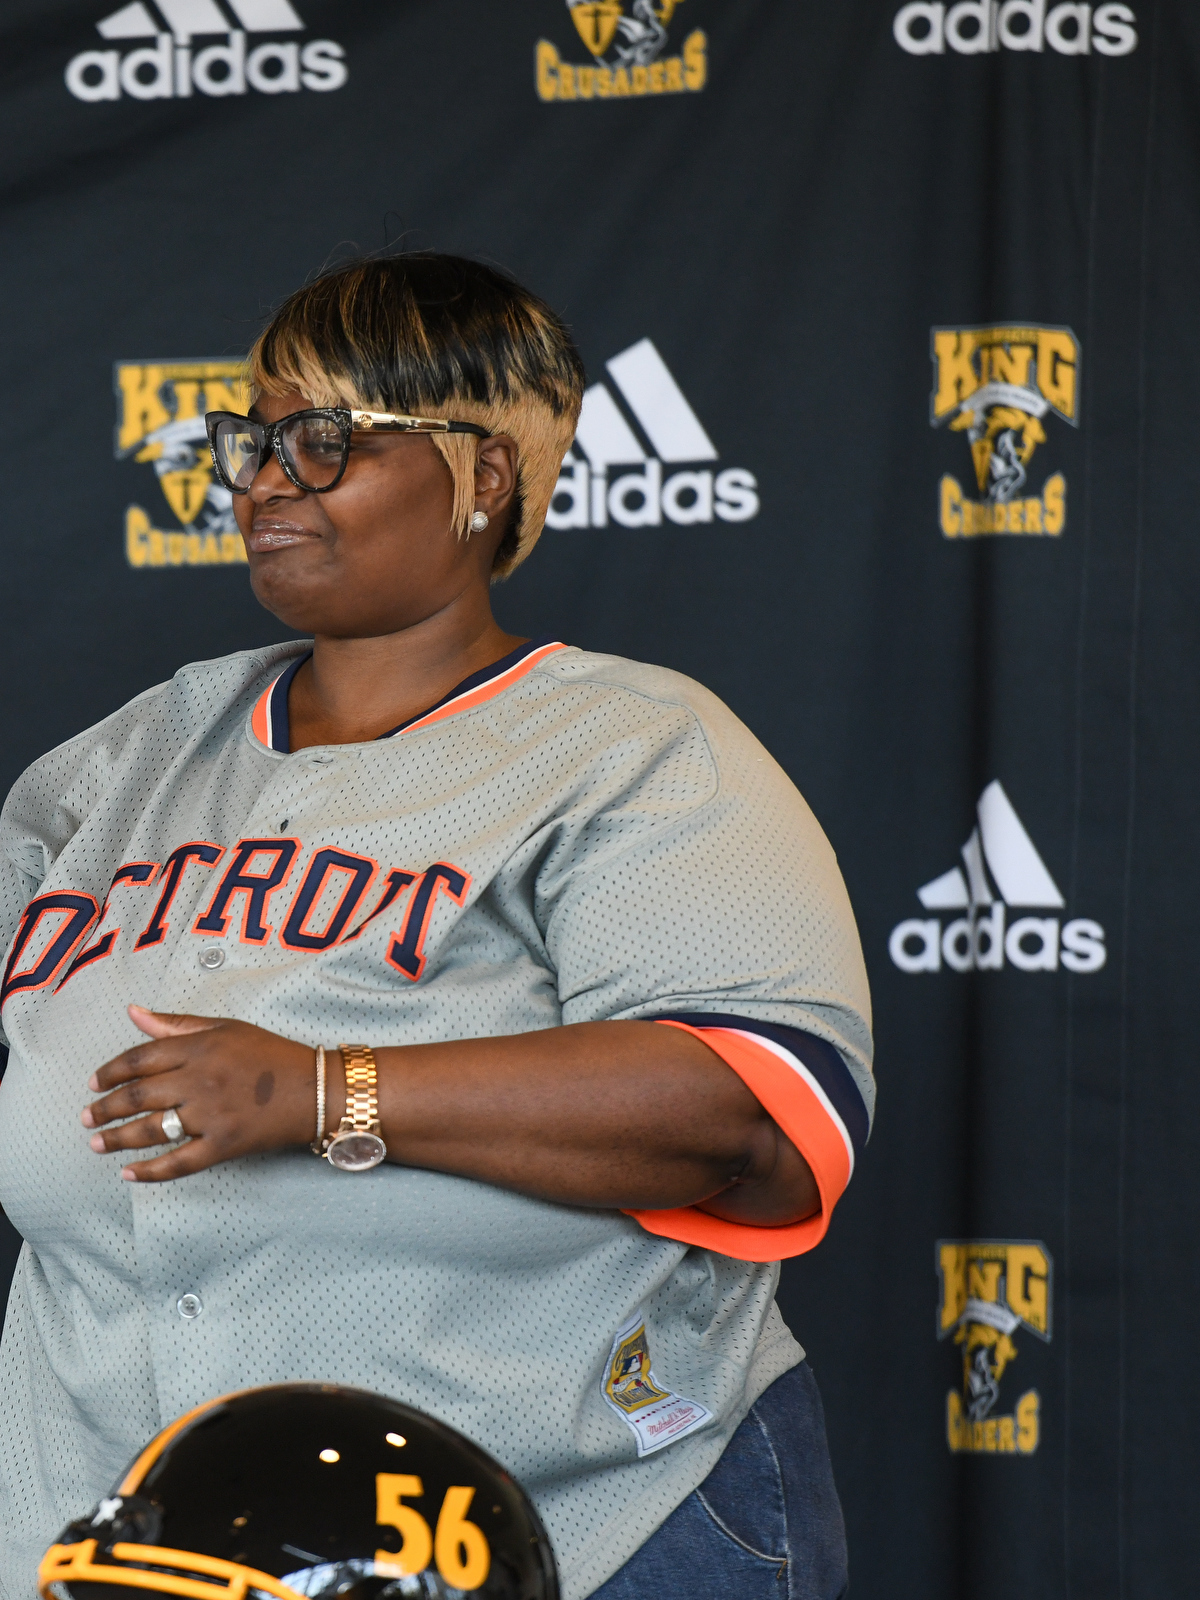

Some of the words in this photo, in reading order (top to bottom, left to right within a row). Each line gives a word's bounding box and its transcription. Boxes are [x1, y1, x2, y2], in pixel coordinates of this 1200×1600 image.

[64, 28, 349, 101] adidas
[534, 28, 707, 102] CRUSADERS
[117, 362, 251, 450] KIN
[544, 458, 760, 530] didas
[1, 837, 474, 1015] DETROIT
[373, 1472, 491, 1592] 56
